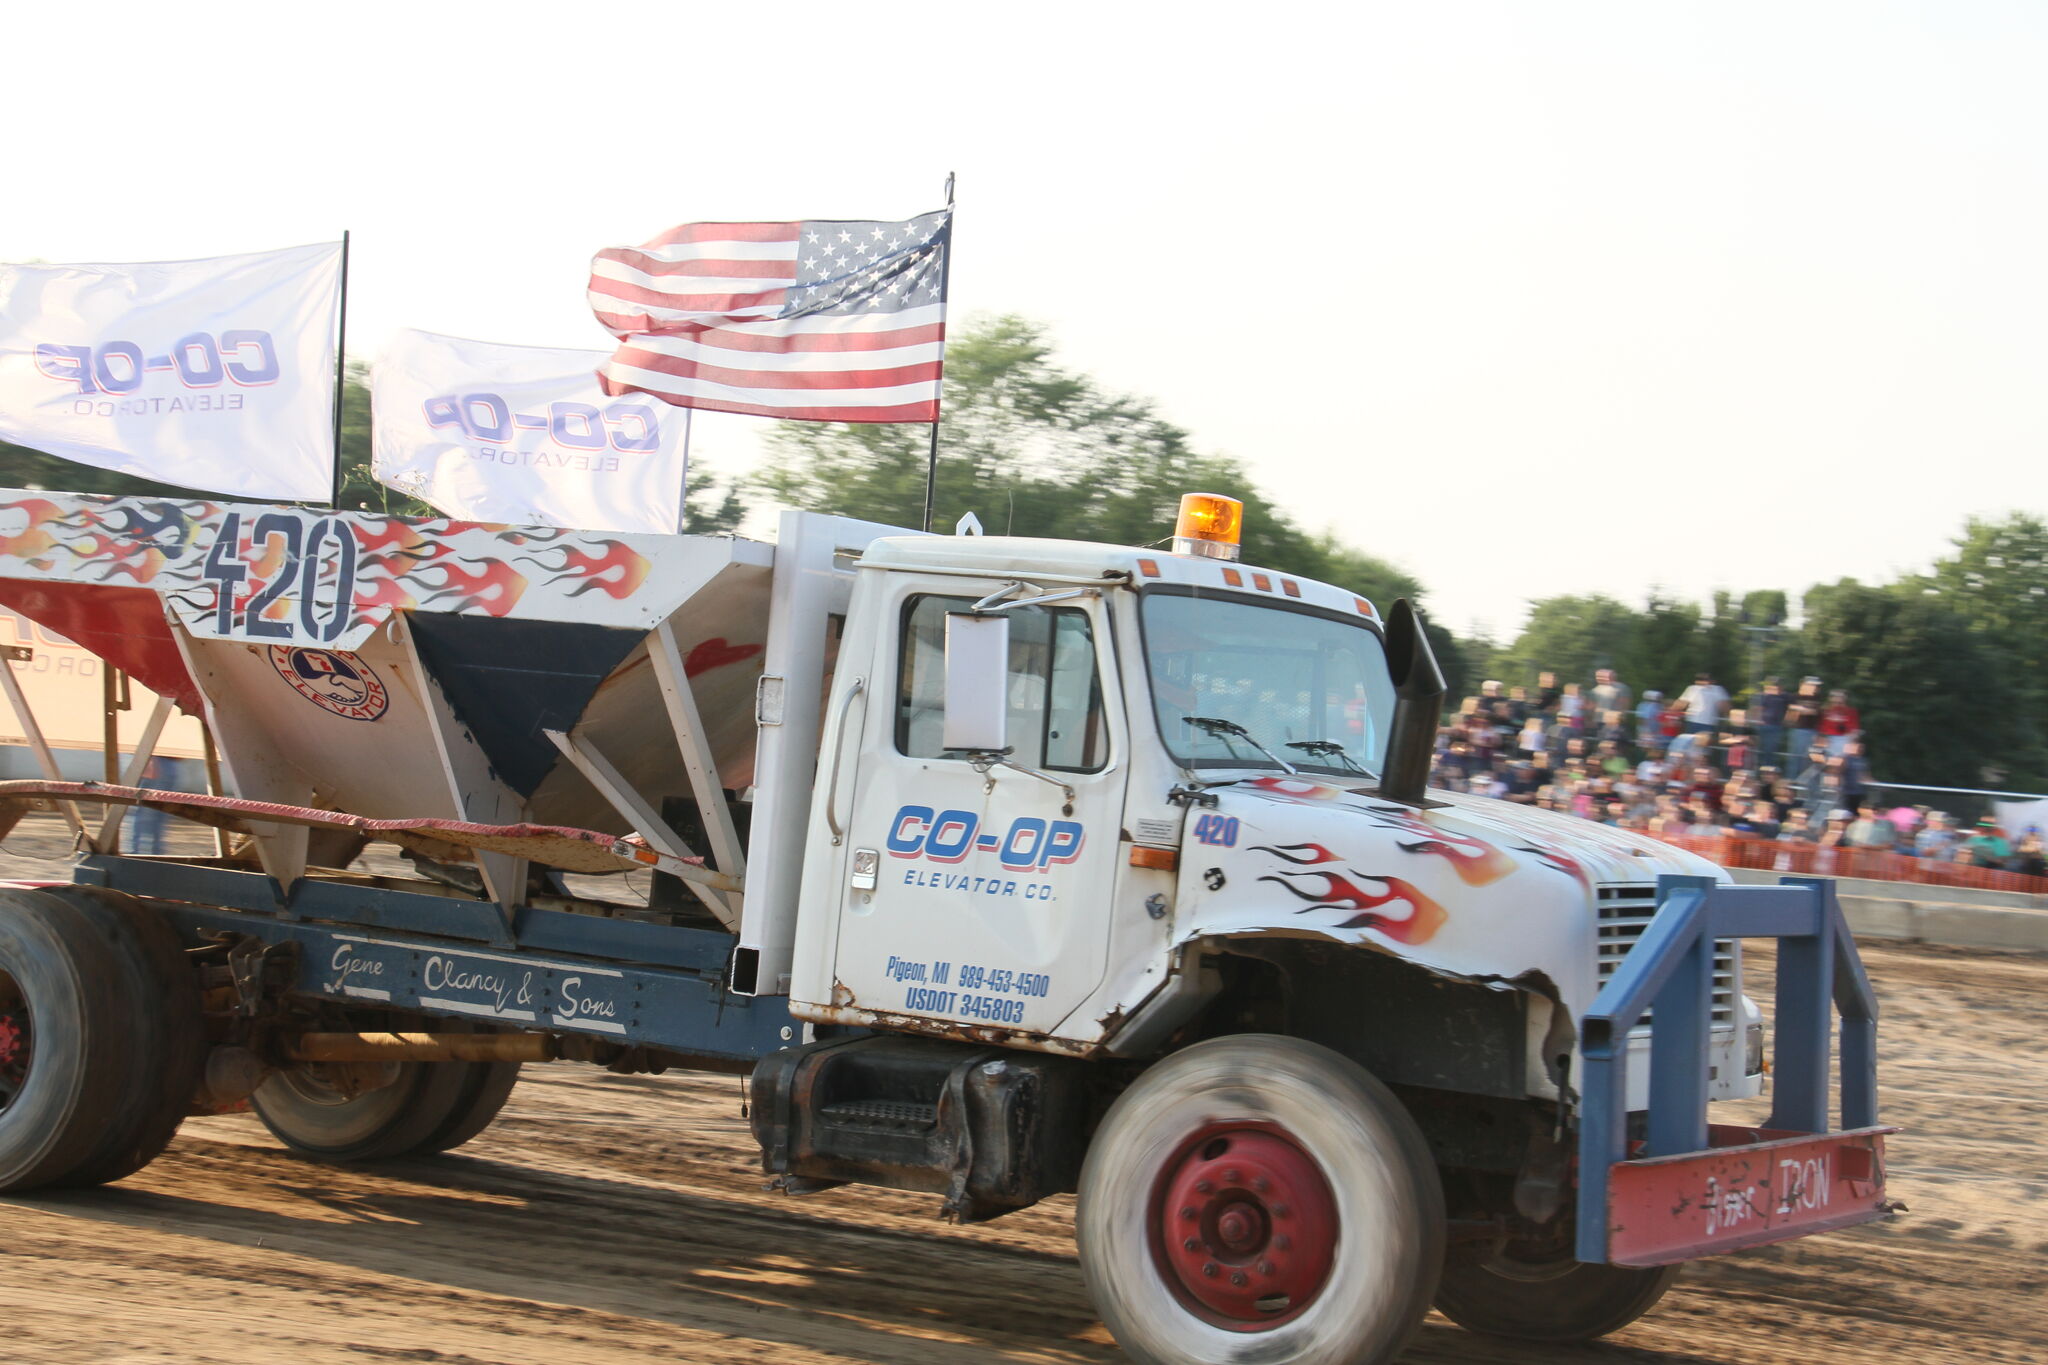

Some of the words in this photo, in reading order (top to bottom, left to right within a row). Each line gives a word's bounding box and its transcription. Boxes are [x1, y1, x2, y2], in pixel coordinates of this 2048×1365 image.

[204, 511, 357, 643] 420
[280, 668, 385, 718] ELEVATOR
[886, 804, 1086, 875] CO-OP
[1193, 813, 1240, 848] 420
[903, 869, 1017, 898] ELEVATOR
[1024, 883, 1057, 902] CO.
[330, 943, 384, 990] Gene
[424, 956, 511, 1012] Clancy
[516, 971, 534, 1005] &
[558, 976, 616, 1018] Sons
[885, 955, 929, 985] Pigeon,
[931, 963, 950, 985] MI
[958, 965, 1050, 998] 989-453-4500
[905, 987, 958, 1014] USDOT
[960, 993, 1025, 1024] 345803
